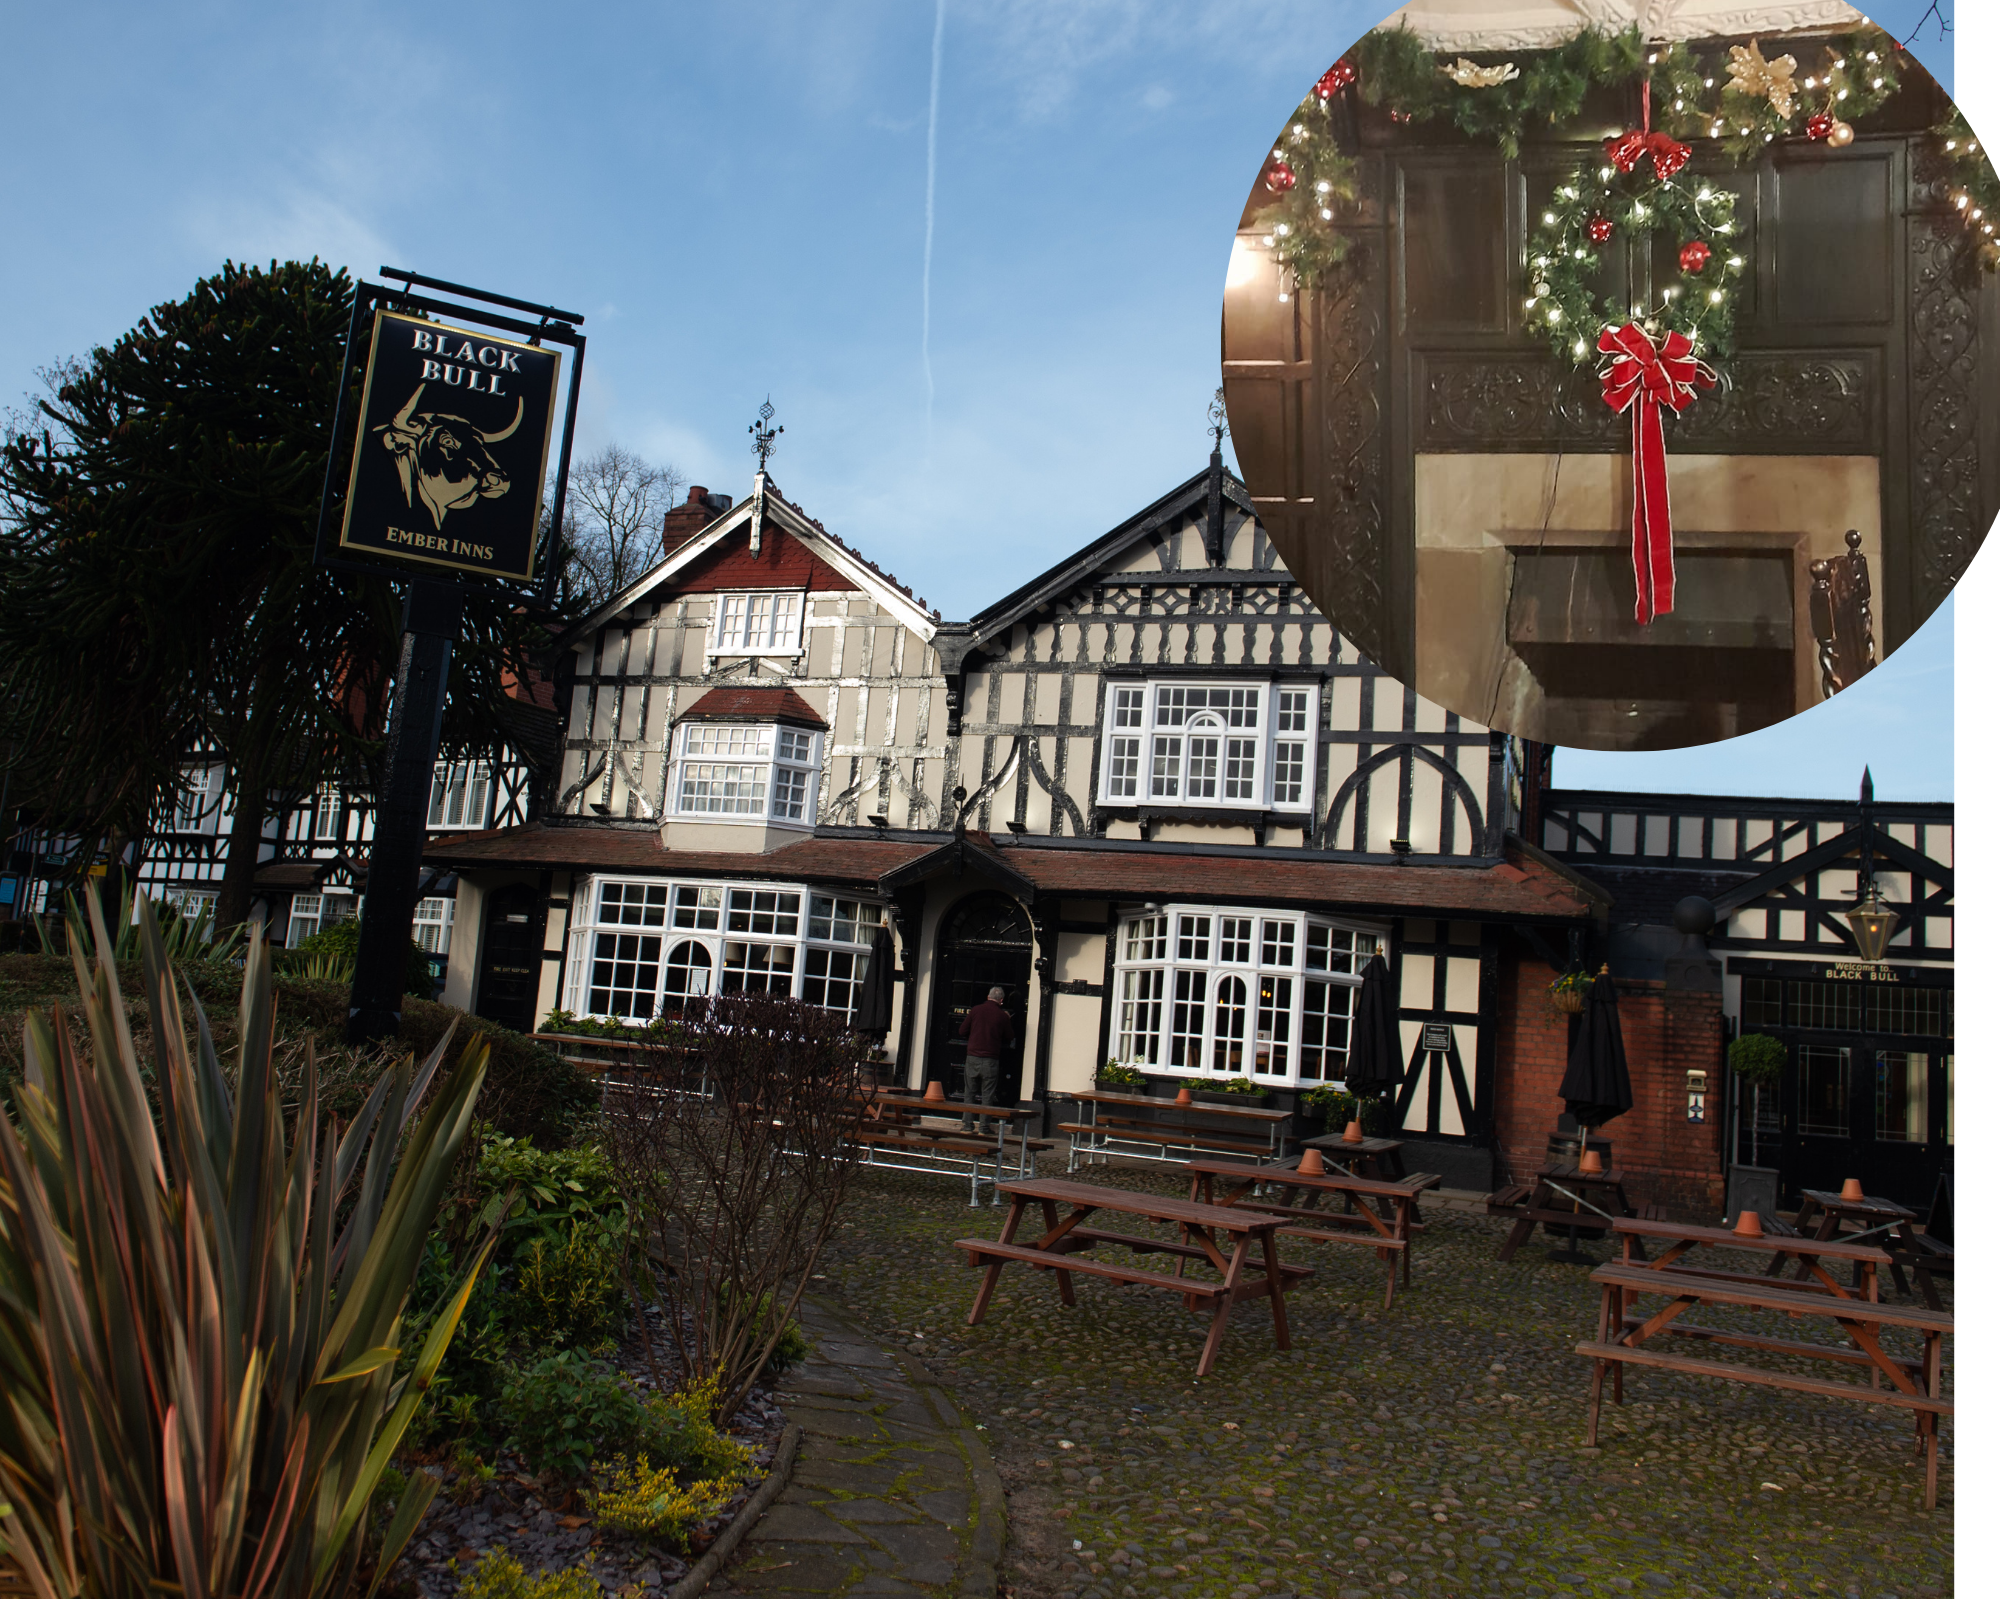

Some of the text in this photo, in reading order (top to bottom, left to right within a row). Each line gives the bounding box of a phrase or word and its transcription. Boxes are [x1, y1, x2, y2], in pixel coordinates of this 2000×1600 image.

[411, 329, 522, 374] BLACK
[420, 358, 507, 397] BULL
[386, 526, 494, 561] EMBER INNS
[1826, 969, 1899, 982] BLACK BULL
[1835, 962, 1876, 972] Welcome
